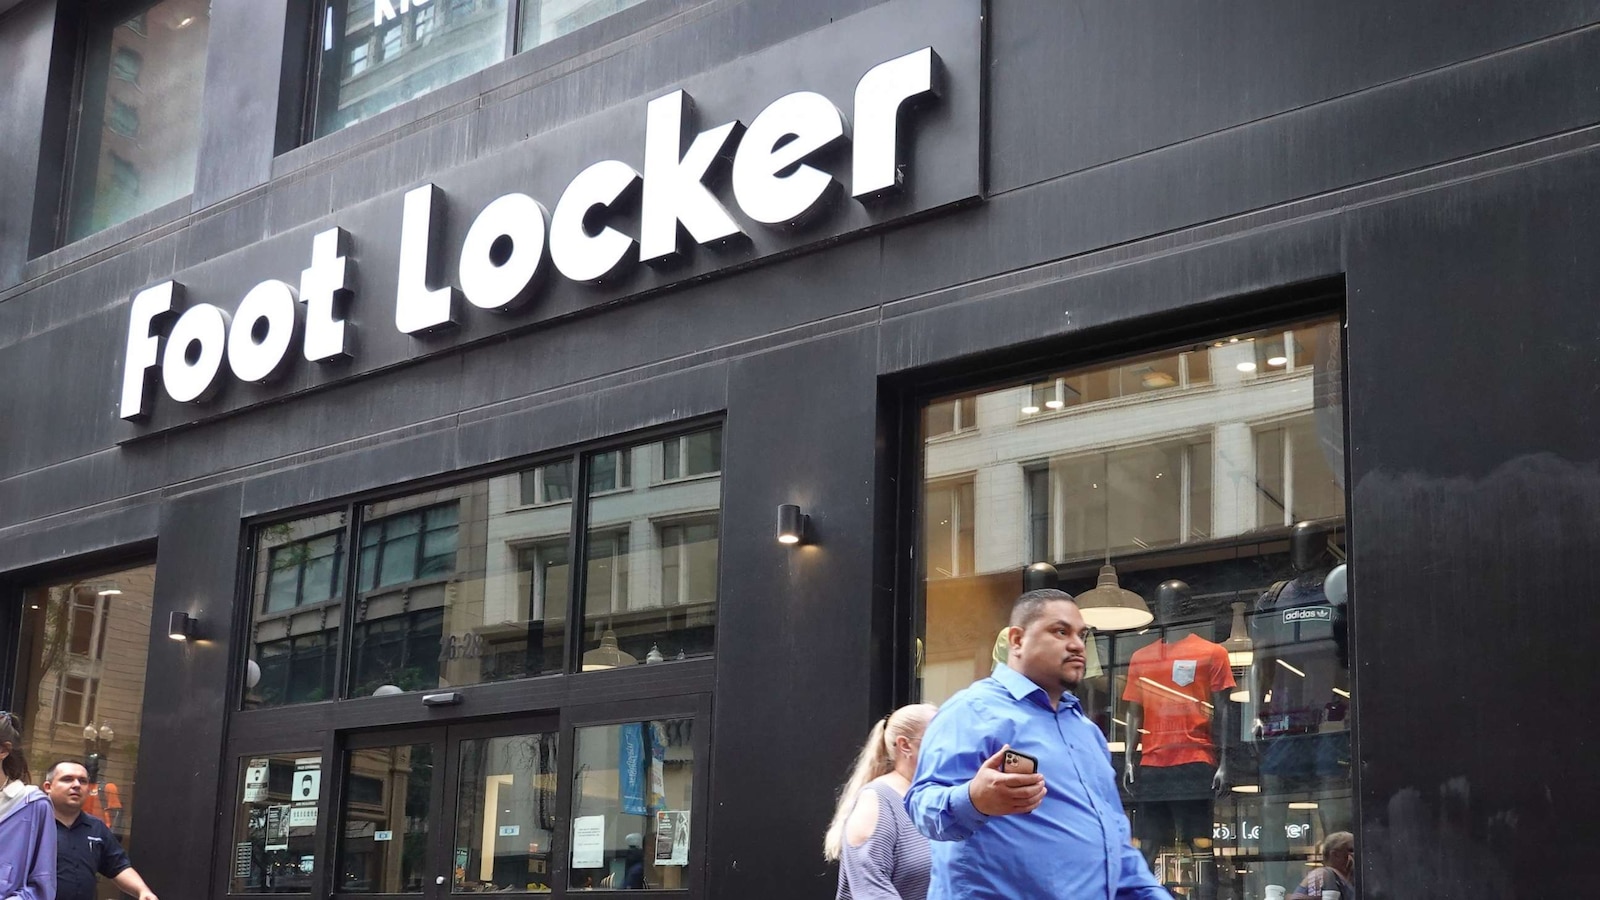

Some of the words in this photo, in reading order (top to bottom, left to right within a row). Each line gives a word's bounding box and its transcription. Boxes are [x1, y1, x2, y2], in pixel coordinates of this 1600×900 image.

[120, 226, 350, 420] Foot
[395, 46, 936, 334] Locker
[1285, 610, 1316, 620] adidas
